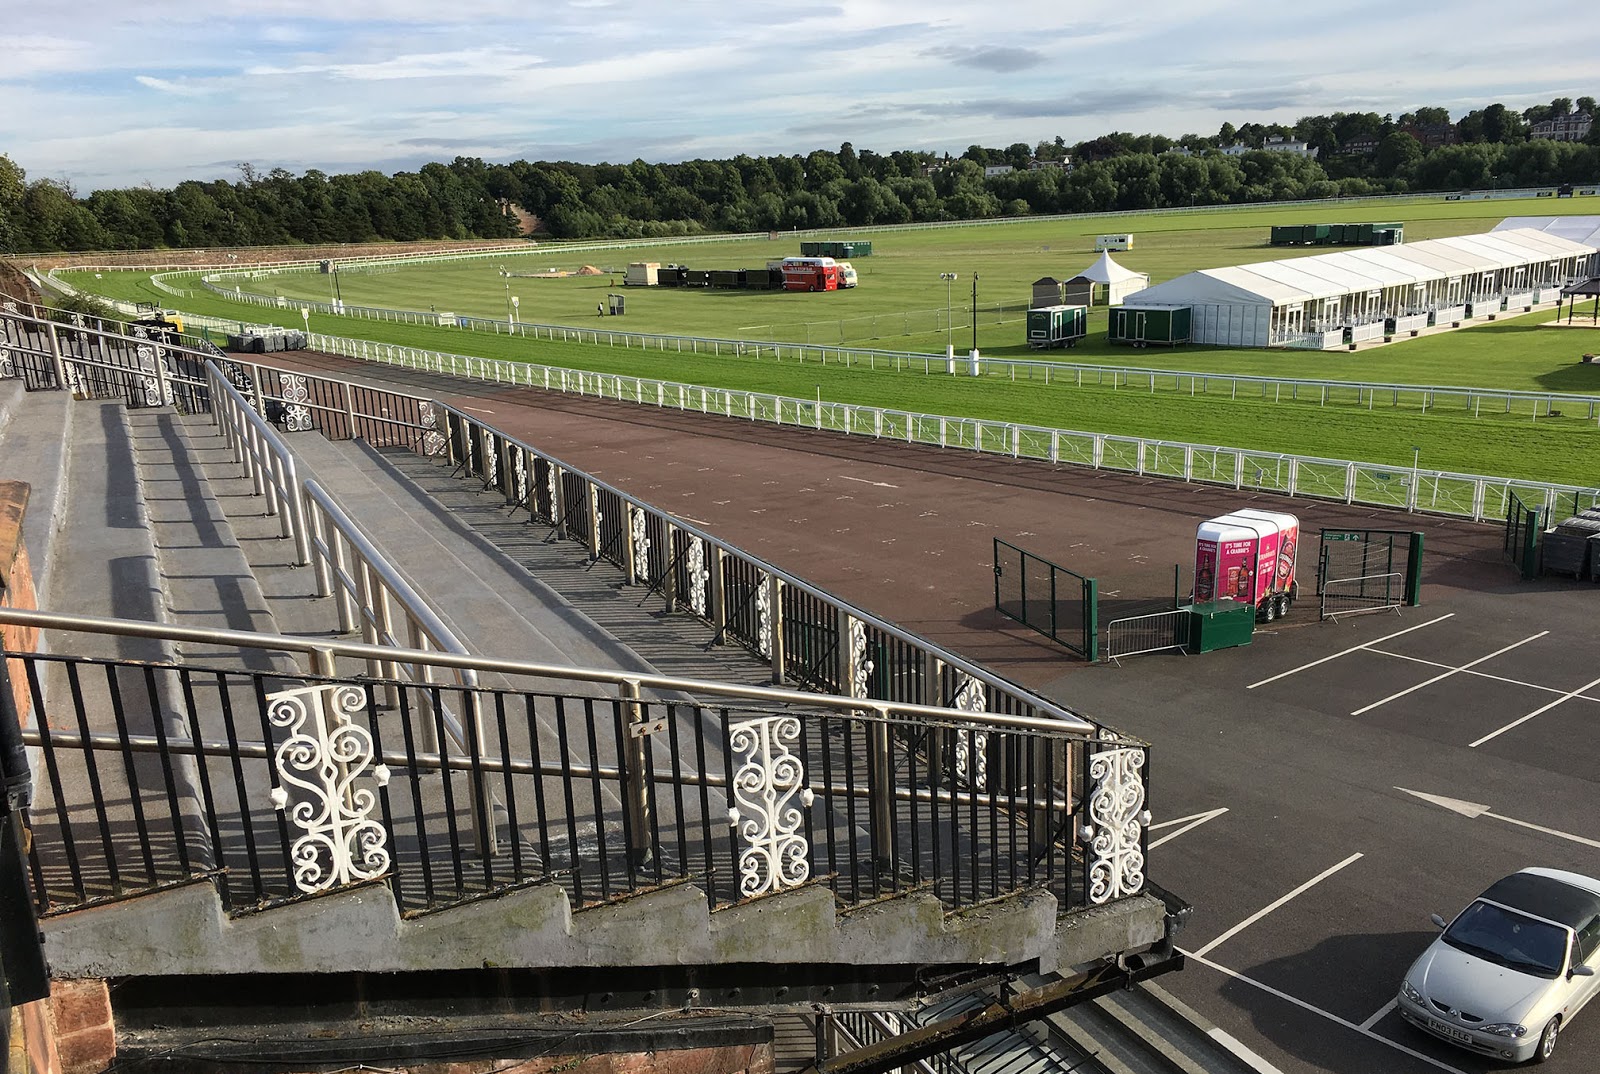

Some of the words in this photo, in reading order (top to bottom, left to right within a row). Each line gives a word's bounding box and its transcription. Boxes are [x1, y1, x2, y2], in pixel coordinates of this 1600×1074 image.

[1230, 547, 1250, 555] CRABBIE'S
[1431, 1020, 1452, 1034] FN03
[1453, 1030, 1469, 1041] FLG
